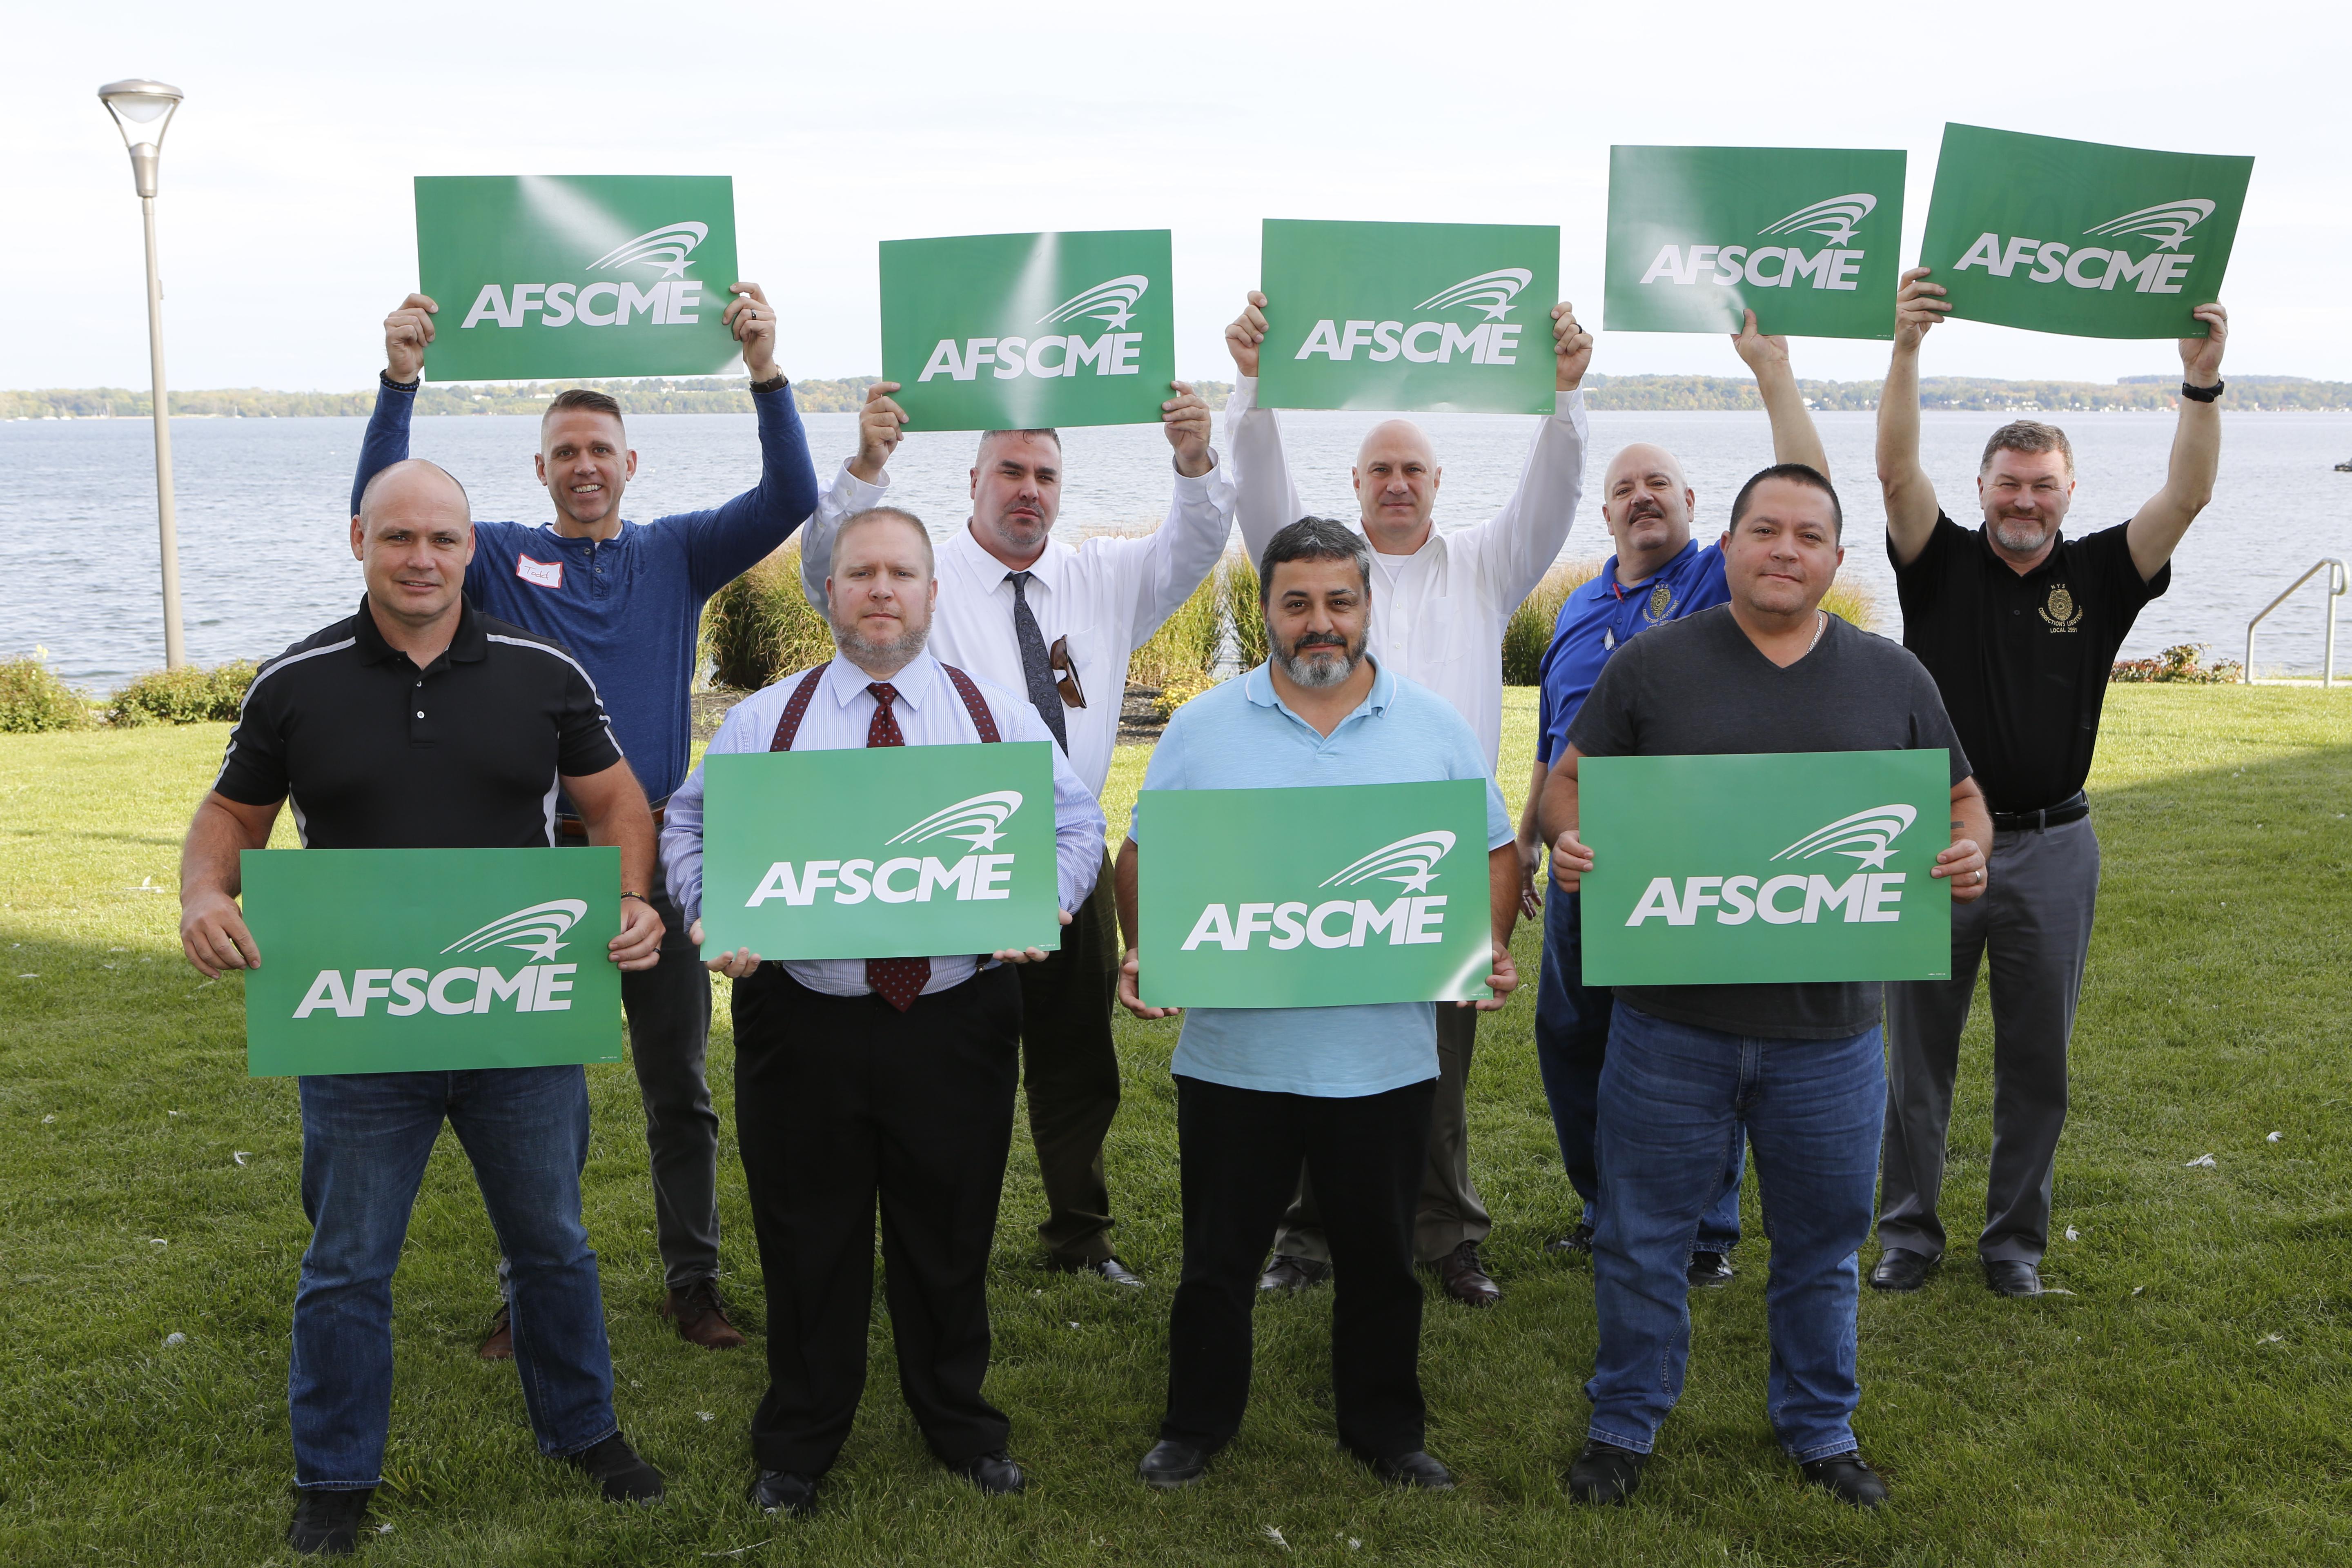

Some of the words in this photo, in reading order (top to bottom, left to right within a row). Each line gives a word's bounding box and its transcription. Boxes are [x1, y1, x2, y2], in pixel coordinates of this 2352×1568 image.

[1639, 245, 1865, 290] AFSCME
[1953, 232, 2195, 294] AFSCME
[461, 281, 703, 329] AFSCME
[917, 332, 1143, 382] AFSCME
[1294, 320, 1522, 365] AFSCME
[524, 565, 550, 580] Todd
[2038, 607, 2065, 626] CORRECTIONS
[744, 853, 1015, 907] AFSCME
[1624, 872, 1906, 927] AFSCME
[1180, 895, 1448, 951] AFSCME
[292, 963, 577, 1018] AFSCME
